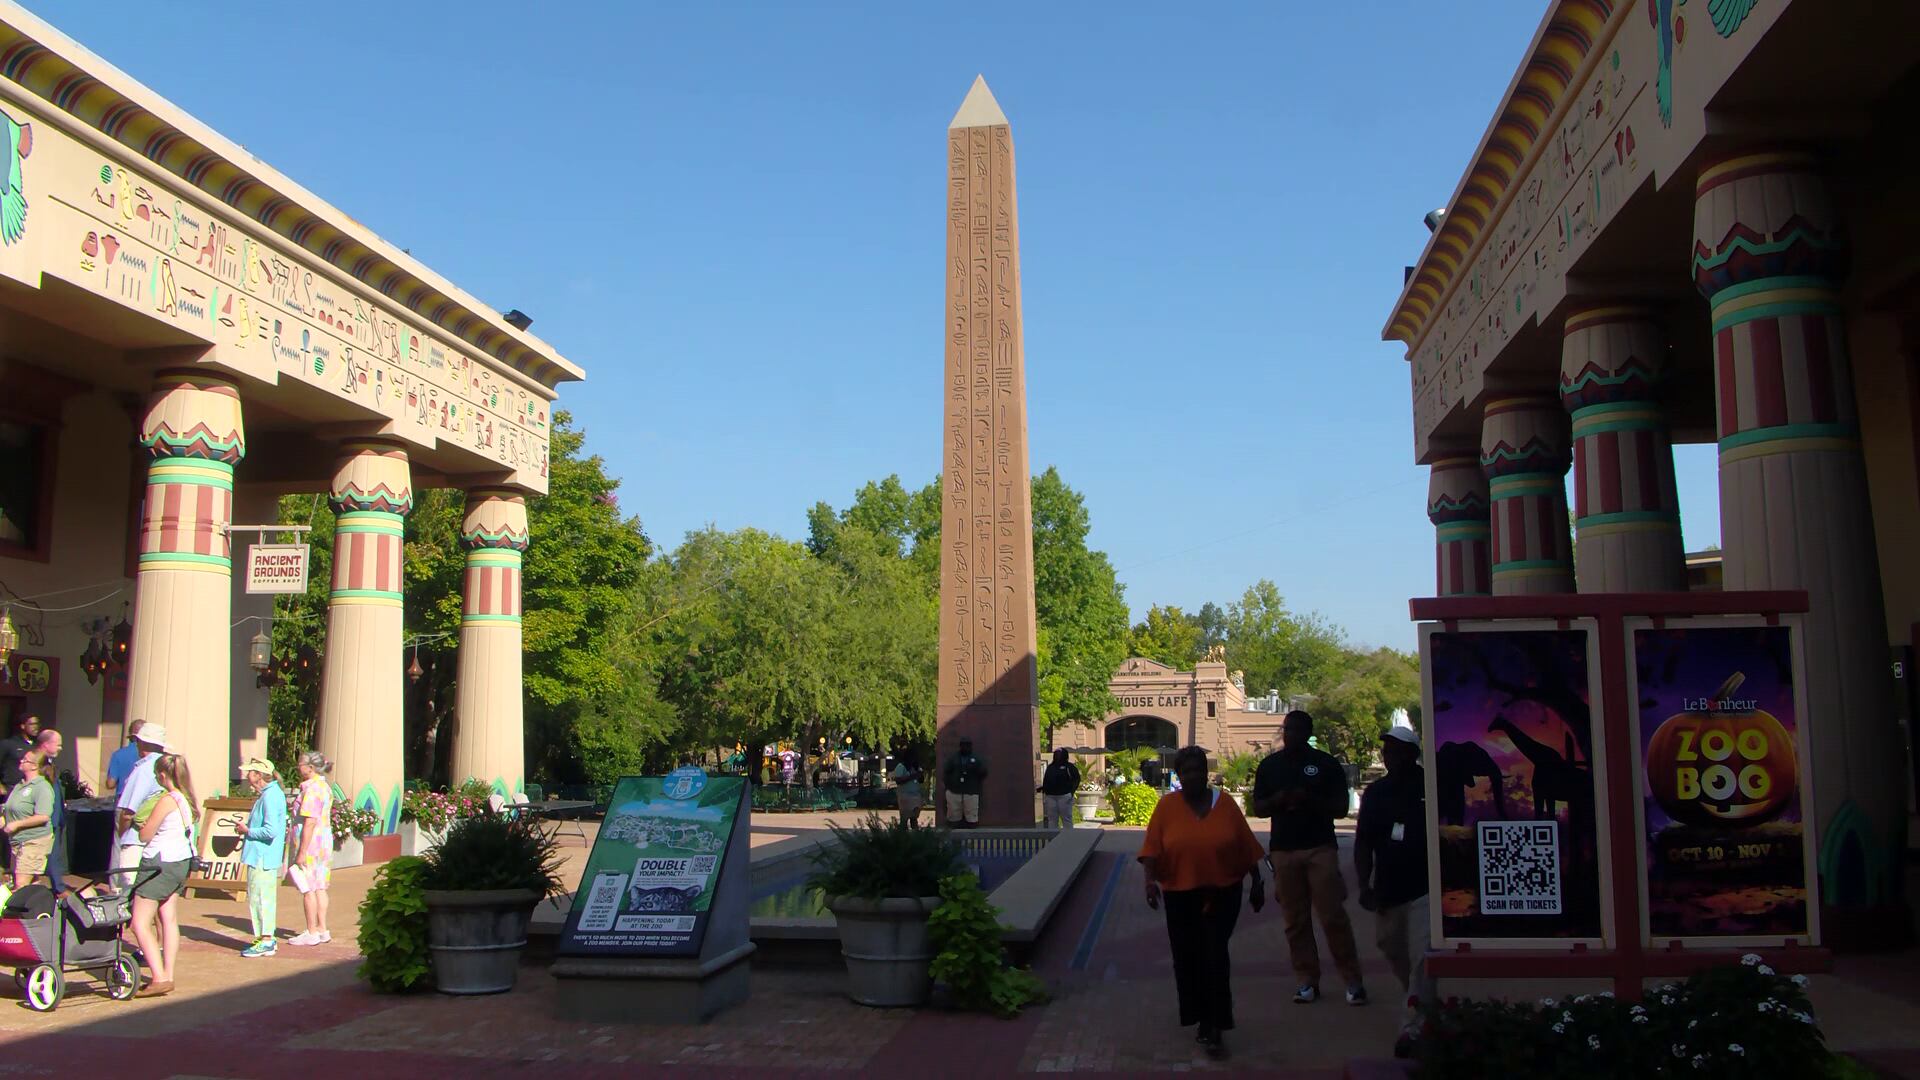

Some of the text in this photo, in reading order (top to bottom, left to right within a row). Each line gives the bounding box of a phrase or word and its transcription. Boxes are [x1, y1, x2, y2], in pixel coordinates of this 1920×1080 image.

[255, 555, 301, 566] ANCIENT
[254, 567, 301, 577] GROUNDS
[1158, 696, 1188, 707] CAFE
[1677, 729, 1769, 761] ZOO
[1677, 764, 1771, 800] BOO
[1667, 846, 1702, 861] OCT
[1706, 846, 1724, 861] 10
[1737, 843, 1772, 859] NOV
[640, 860, 687, 870] DOUBLE
[1486, 899, 1557, 910] SCAN FOR TICKETS
